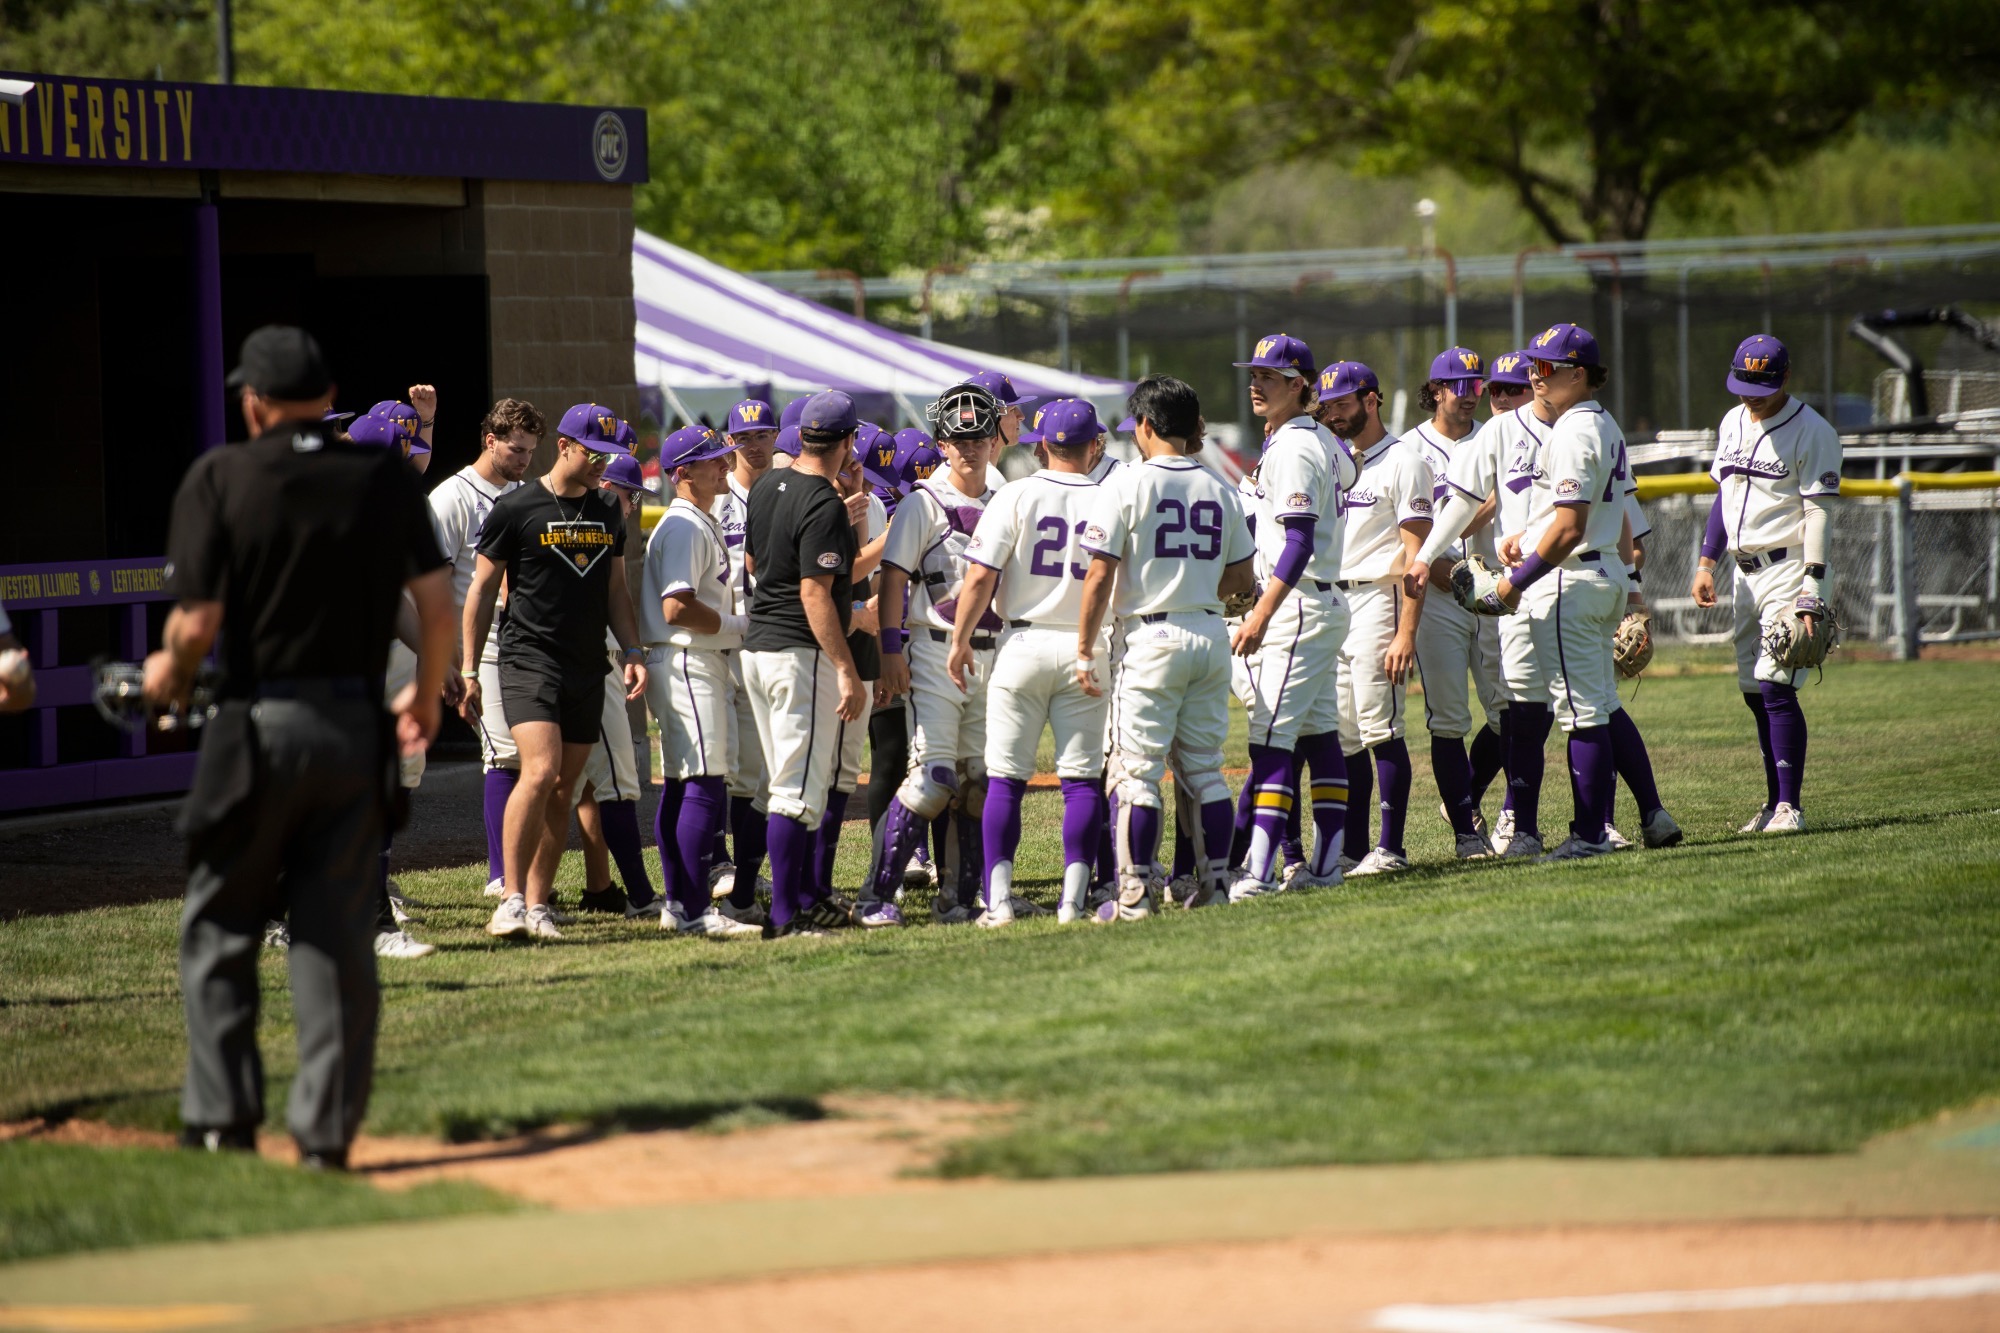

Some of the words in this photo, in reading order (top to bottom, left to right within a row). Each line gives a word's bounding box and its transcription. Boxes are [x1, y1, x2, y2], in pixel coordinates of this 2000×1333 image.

[1254, 341, 1275, 358] W
[1459, 354, 1479, 371] W
[1497, 357, 1519, 373] W
[1744, 357, 1768, 371] W
[1321, 371, 1338, 390] W
[739, 404, 762, 423] W
[597, 417, 616, 436] W
[878, 449, 895, 467] W
[1719, 445, 1787, 474] Leathernecks
[915, 464, 936, 480] W
[1155, 498, 1203, 560] 29
[0, 575, 41, 600] WESTERN
[42, 572, 80, 597] ILLINOIS
